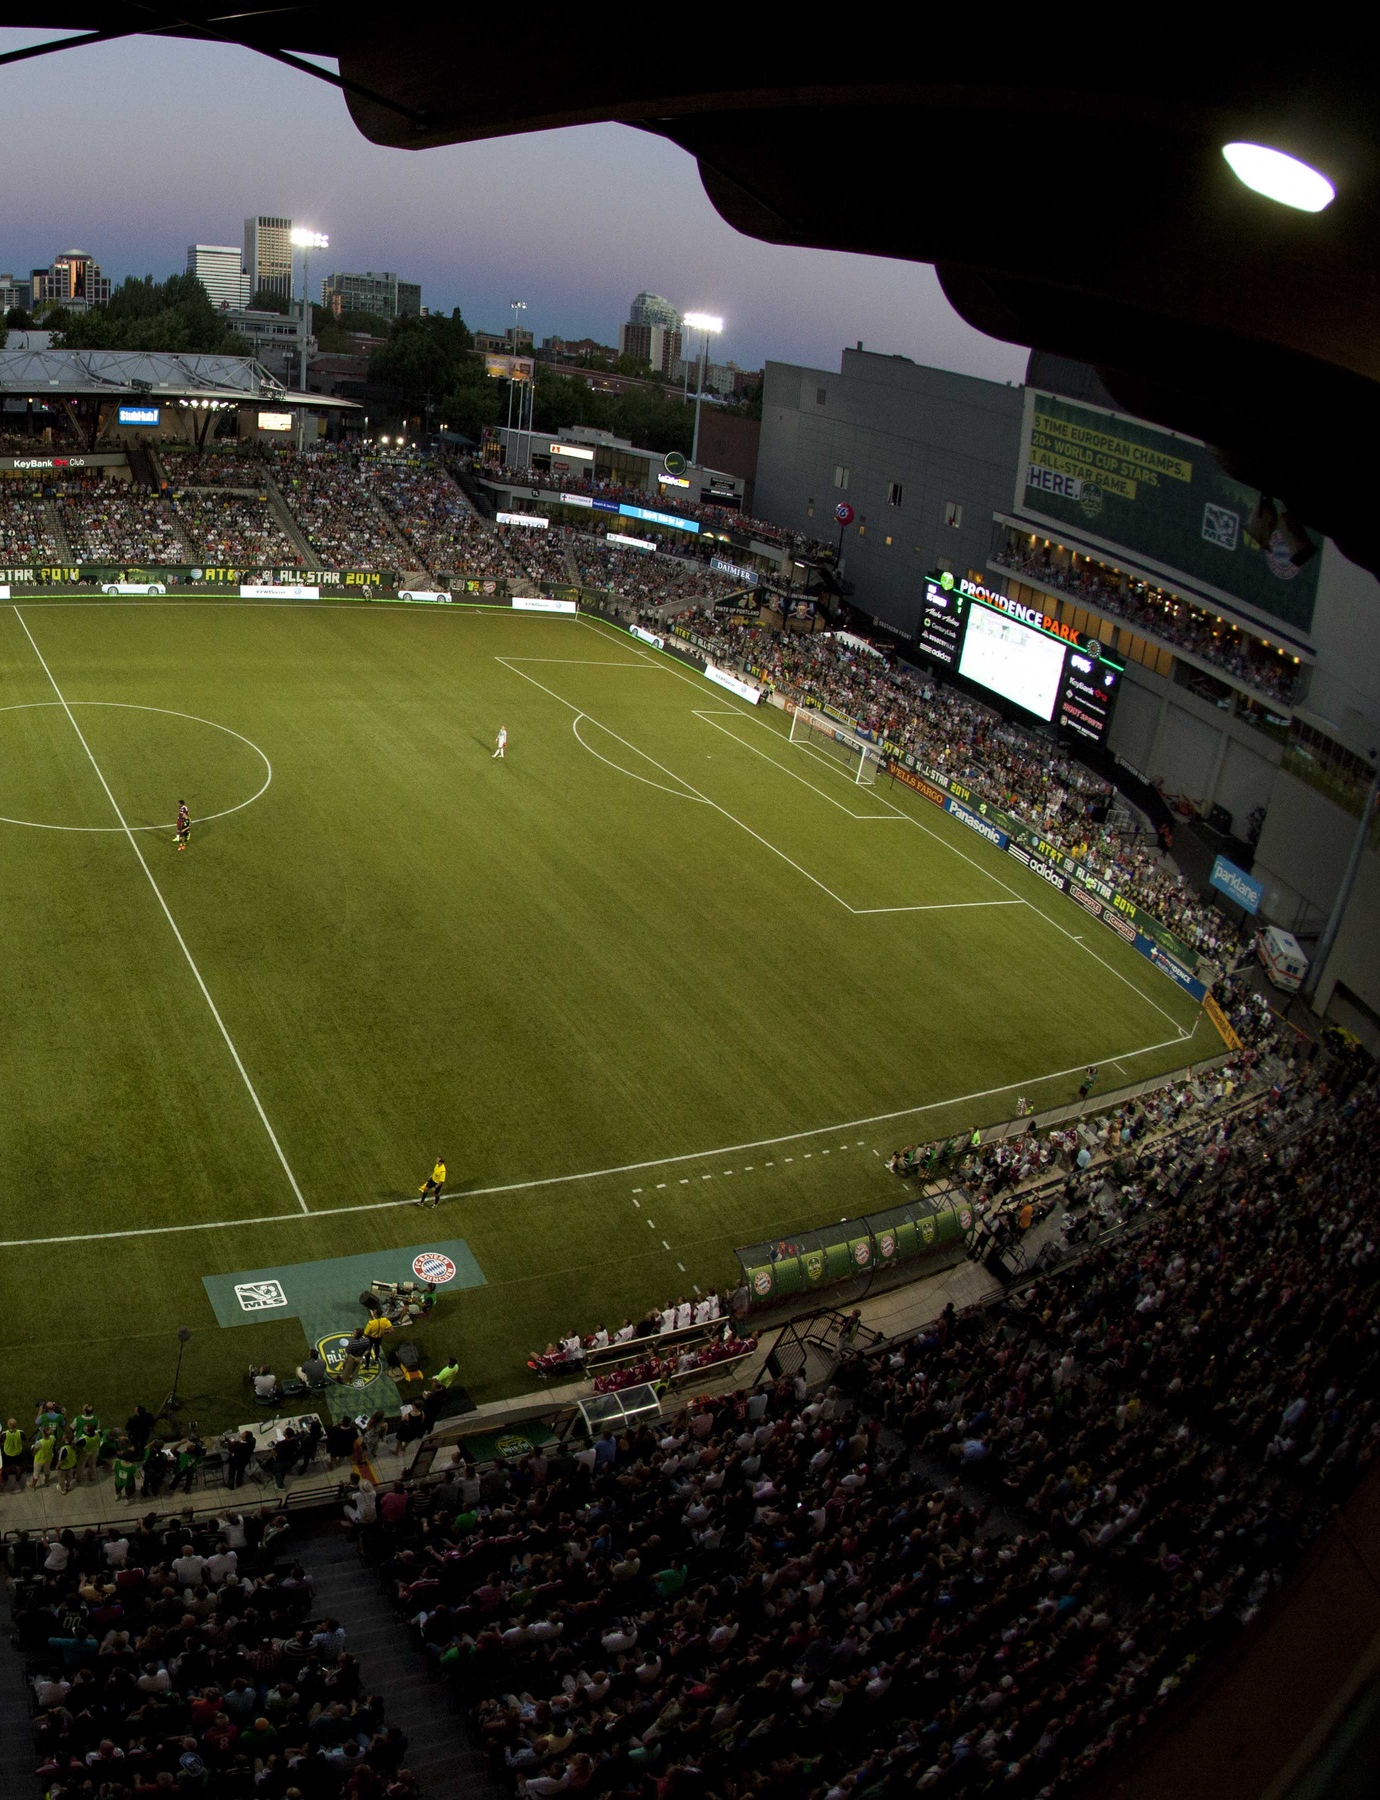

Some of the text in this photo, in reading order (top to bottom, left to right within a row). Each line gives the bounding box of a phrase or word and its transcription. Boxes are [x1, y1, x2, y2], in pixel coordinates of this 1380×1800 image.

[1032, 431, 1052, 447] 20+
[1054, 440, 1094, 463] WORLD
[1096, 451, 1119, 472] CUP
[1035, 414, 1186, 477] 5 TIME EUROPEAN CHAMPS.
[13, 457, 85, 469] KeyBank Club
[1040, 453, 1093, 478] ALL-STAR
[1096, 475, 1130, 494] GAME.
[1029, 466, 1078, 498] HERE.
[345, 573, 381, 586] 2014
[960, 578, 1044, 626] PROVIDENCE
[1041, 615, 1081, 645] PARK
[931, 649, 952, 663] adidas
[889, 763, 943, 804] WELLS FARGO
[949, 781, 971, 801] 2014
[948, 800, 1001, 844] Panasonic
[1038, 840, 1064, 864] AT&T
[1029, 859, 1065, 890] adidas
[1213, 865, 1259, 903] parklane
[1075, 890, 1101, 914] CHIPOTLE
[1112, 893, 1137, 919] 2014
[1110, 915, 1136, 940] CHIPOTLE
[416, 1256, 423, 1268] FC
[421, 1252, 451, 1264] BAYERN
[243, 1299, 284, 1310] MLS
